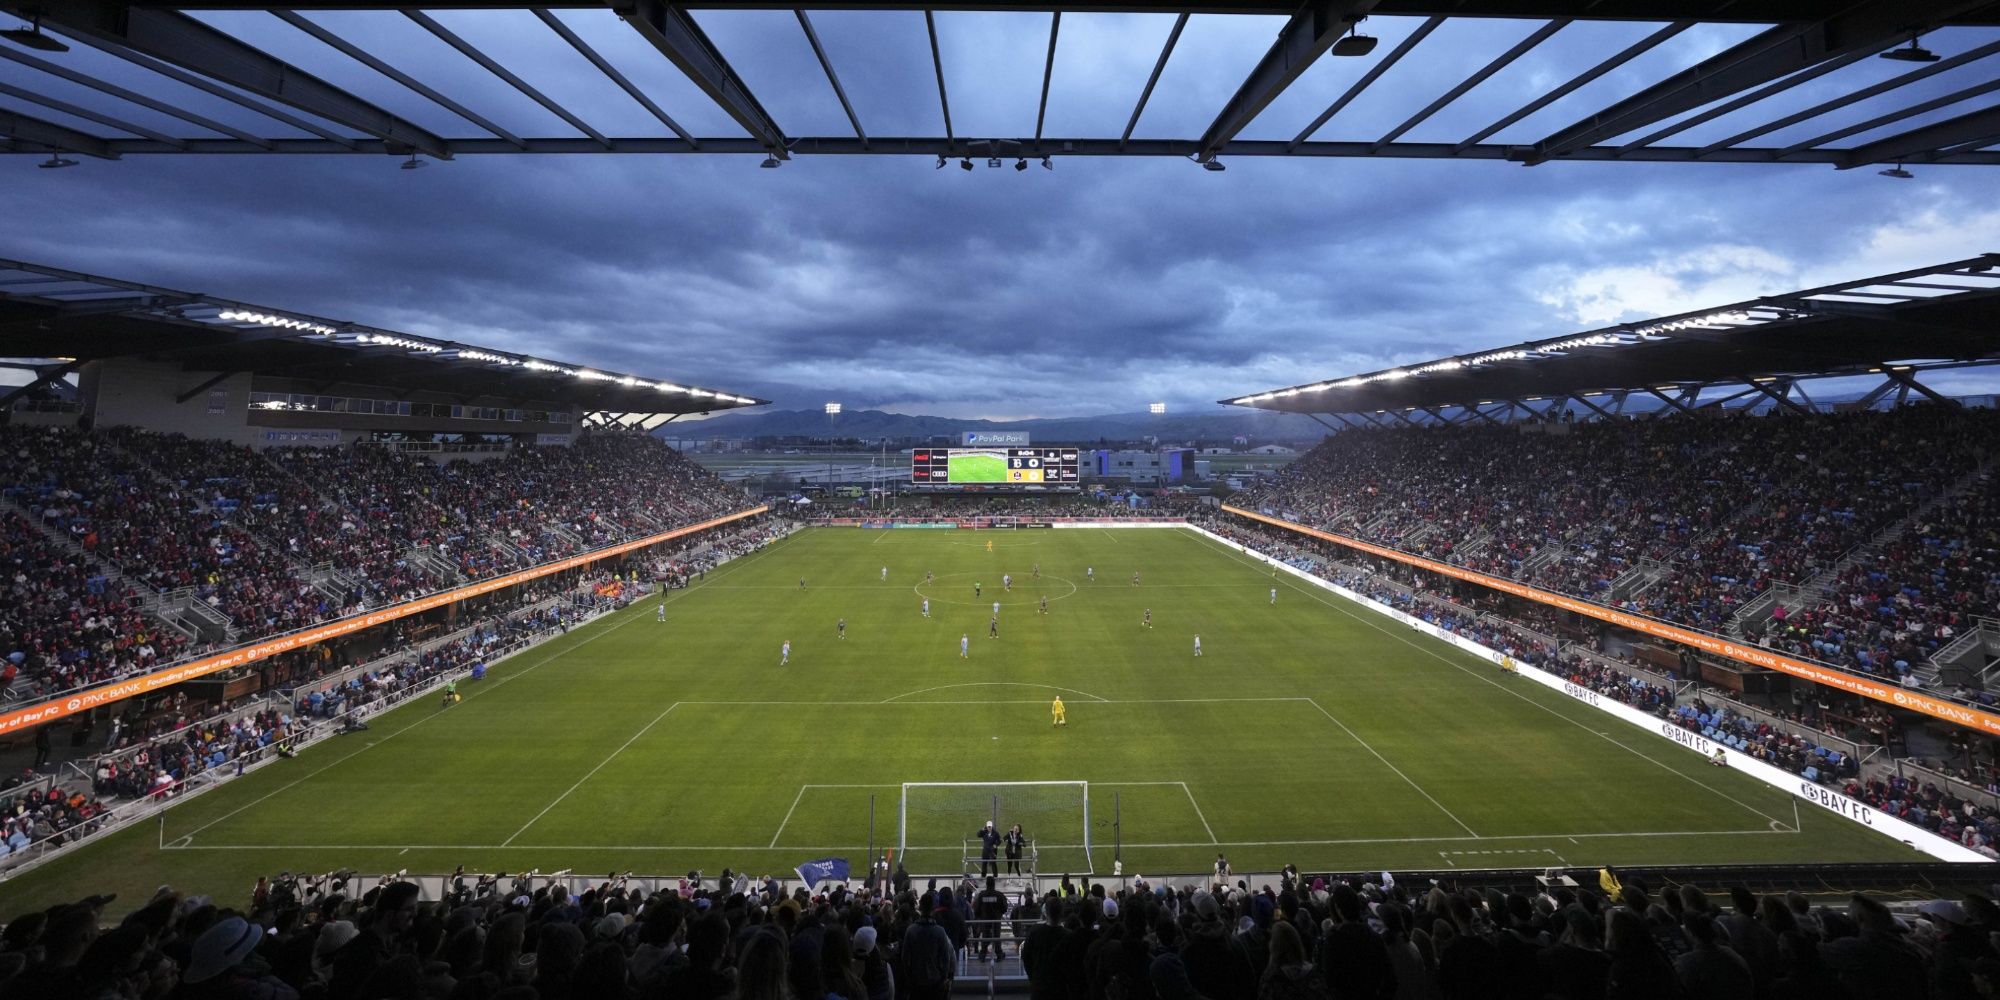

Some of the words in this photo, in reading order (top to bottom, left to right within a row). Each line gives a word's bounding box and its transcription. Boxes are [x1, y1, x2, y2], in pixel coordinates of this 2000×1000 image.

[978, 435, 1005, 444] PayPal
[1006, 434, 1024, 443] Park
[257, 645, 274, 656] PNC
[274, 639, 295, 651] BANK
[1650, 625, 1674, 638] Founding
[1674, 631, 1694, 644] Partner
[1700, 639, 1713, 649] Bay
[1712, 642, 1721, 650] FC
[82, 691, 109, 706] PNC
[109, 682, 141, 698] BANK
[147, 671, 184, 686] Founding
[183, 663, 211, 677] Partner
[211, 660, 221, 669] of
[220, 657, 234, 667] Bay
[233, 654, 243, 662] FC
[1734, 648, 1753, 660] PNC
[1752, 653, 1777, 667] BANK
[1781, 662, 1816, 678] Founding
[1815, 672, 1846, 687] Partner
[1856, 683, 1873, 694] Bay
[1873, 688, 1887, 698] FC
[1574, 685, 1589, 702] BAY
[1589, 692, 1600, 706] FC
[9, 716, 22, 727] of
[23, 712, 43, 723] Bay
[45, 706, 59, 717] FC
[1908, 696, 1937, 712] PNC
[1936, 704, 1976, 724] BANK
[1675, 727, 1693, 747] BAY
[1696, 736, 1709, 754] FC
[1820, 788, 1847, 815] BAY
[1852, 802, 1873, 825] FC
